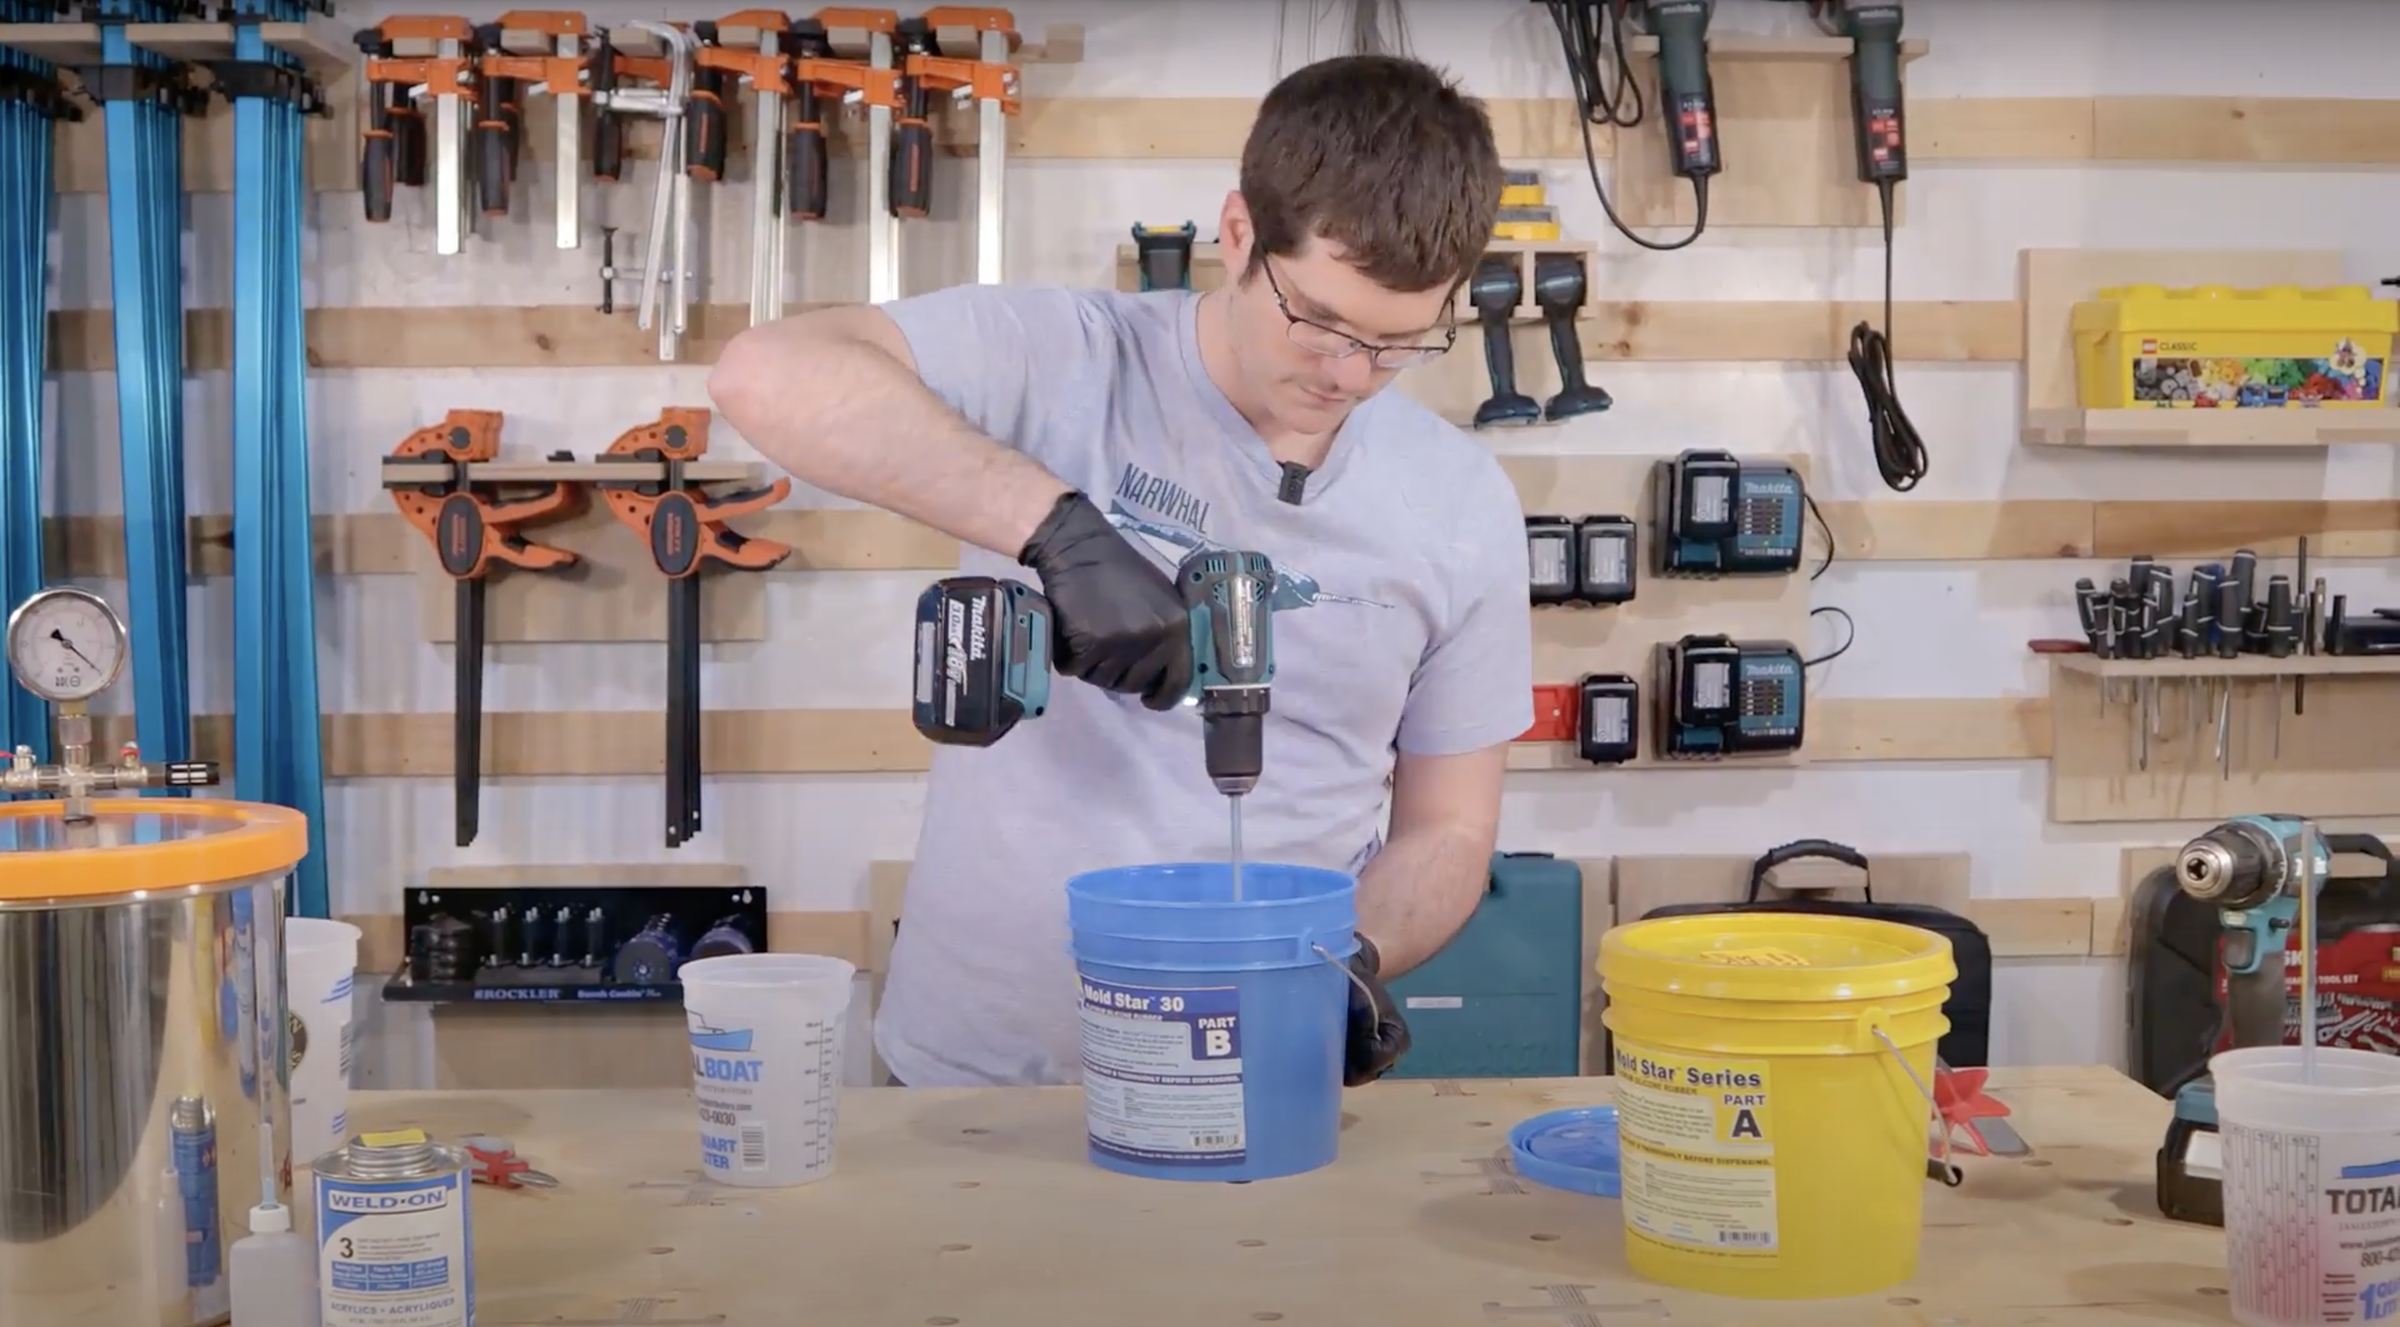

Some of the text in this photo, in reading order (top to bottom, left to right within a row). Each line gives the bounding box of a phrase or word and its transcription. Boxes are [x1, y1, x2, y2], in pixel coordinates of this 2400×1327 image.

[2159, 342, 2198, 351] CLASSIC
[1116, 463, 1210, 534] NARWHAL
[2318, 975, 2342, 984] TOOL
[2343, 974, 2359, 984] SET
[474, 989, 560, 999] ROCKLER
[1160, 997, 1185, 1012] 30
[1199, 1017, 1236, 1029] PART
[1206, 1030, 1232, 1057] B
[1687, 1067, 1761, 1087] Series
[1724, 1094, 1766, 1106] PART
[1732, 1109, 1762, 1138] A
[702, 1133, 737, 1153] UART
[340, 1237, 354, 1259] 3
[389, 1297, 455, 1315] ACRYLIQUES
[2359, 1284, 2376, 1321] 1
